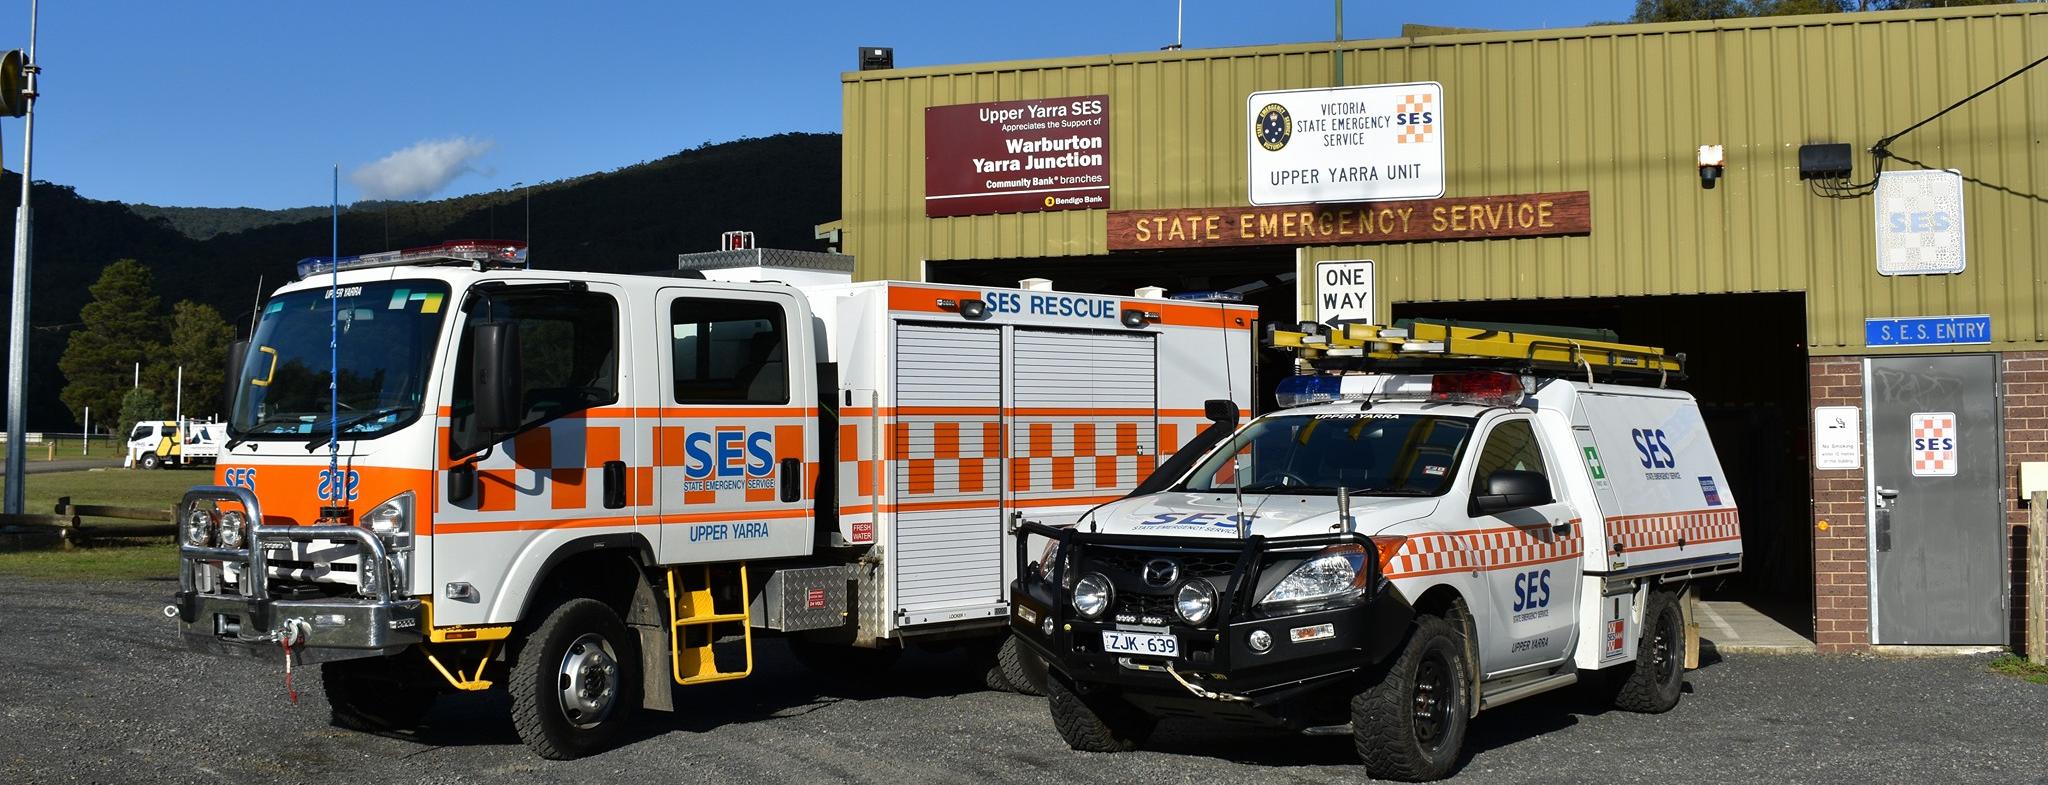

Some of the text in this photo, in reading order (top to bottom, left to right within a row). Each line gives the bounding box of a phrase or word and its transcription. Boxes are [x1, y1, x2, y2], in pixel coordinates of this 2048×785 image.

[980, 101, 1102, 123] Upper Yarra SES
[1321, 102, 1366, 116] VICTORIA
[1002, 122, 1046, 132] Appreciates
[1047, 120, 1060, 128] the
[1061, 119, 1092, 128] Support
[1297, 116, 1391, 133] STATE EMERGENCY
[1397, 112, 1433, 125] SES
[1006, 135, 1102, 153] Warburton
[1323, 133, 1365, 147] SERVICE
[973, 152, 1102, 173] Yarra Junction
[986, 178, 1031, 189] Community
[1060, 174, 1102, 184] branches
[1271, 164, 1421, 185] UPPER YARRA UNIT
[1055, 196, 1102, 205] Bendigo Bank
[1136, 200, 1555, 242] STATE EMERGENCY SERVICE
[1890, 211, 1950, 233] SES
[1326, 269, 1364, 286] ONE
[325, 286, 362, 299] UPER YARRA
[1324, 292, 1367, 309] WAY
[985, 292, 1115, 318] SES RESCUE
[1936, 322, 1985, 338] ENTRY
[1632, 428, 1675, 469] SES
[1915, 438, 1953, 450] SES
[685, 432, 773, 477] SES
[684, 479, 775, 491] STATE EMERGENCY SERVICE
[690, 522, 768, 542] UPPER YARRA
[1513, 569, 1551, 612] SES
[1512, 637, 1549, 653] UPPER YARRA
